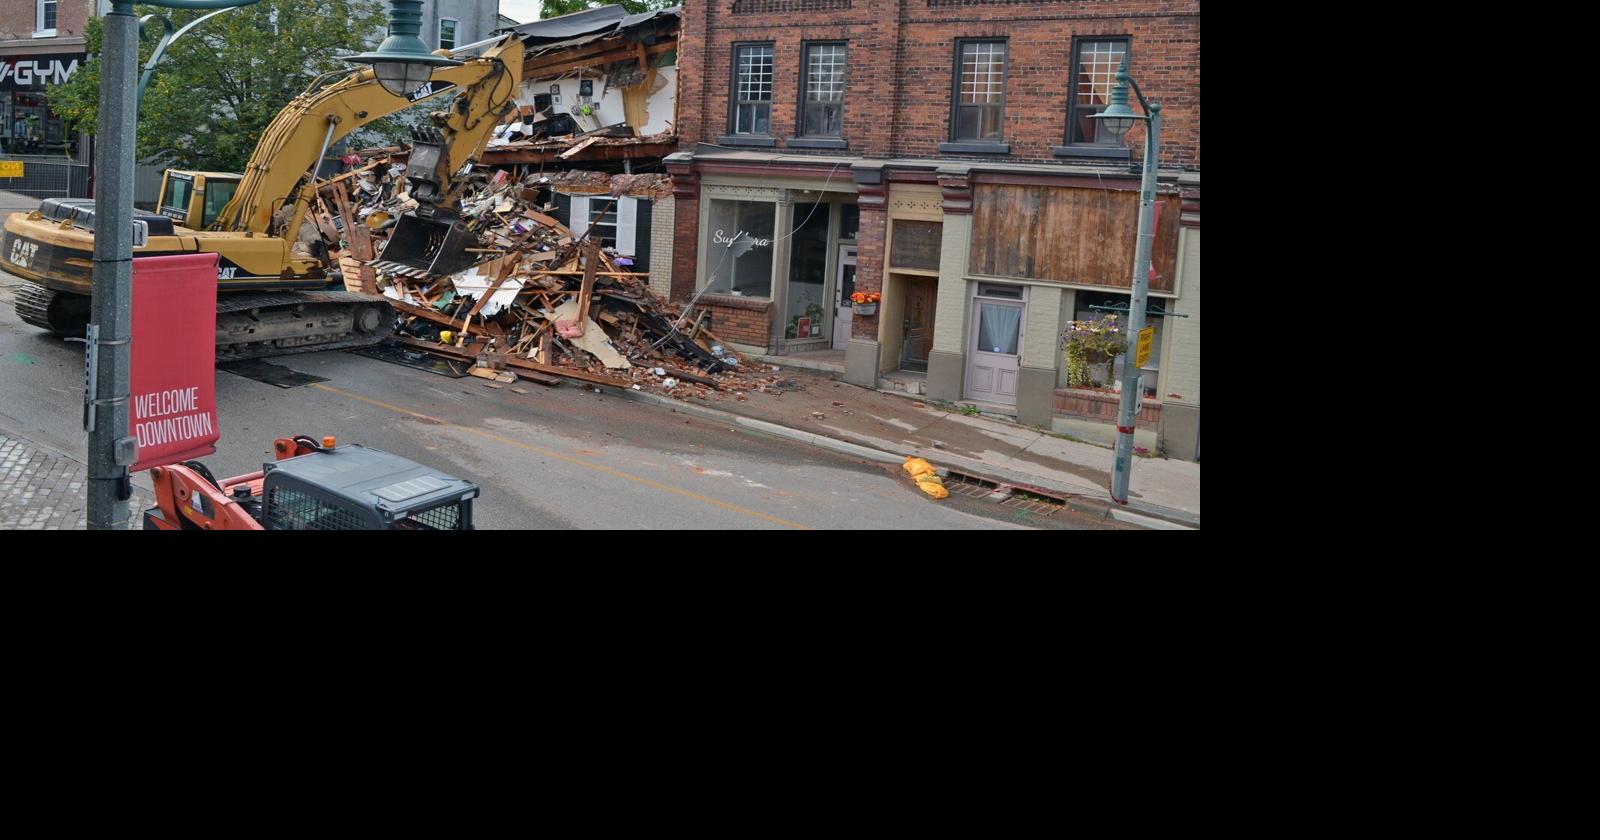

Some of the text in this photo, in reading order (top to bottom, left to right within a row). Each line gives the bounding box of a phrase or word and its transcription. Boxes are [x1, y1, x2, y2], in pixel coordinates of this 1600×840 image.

[10, 238, 39, 268] CAT
[134, 386, 199, 419] WELCOME
[135, 411, 213, 448] DOWNTOWN
